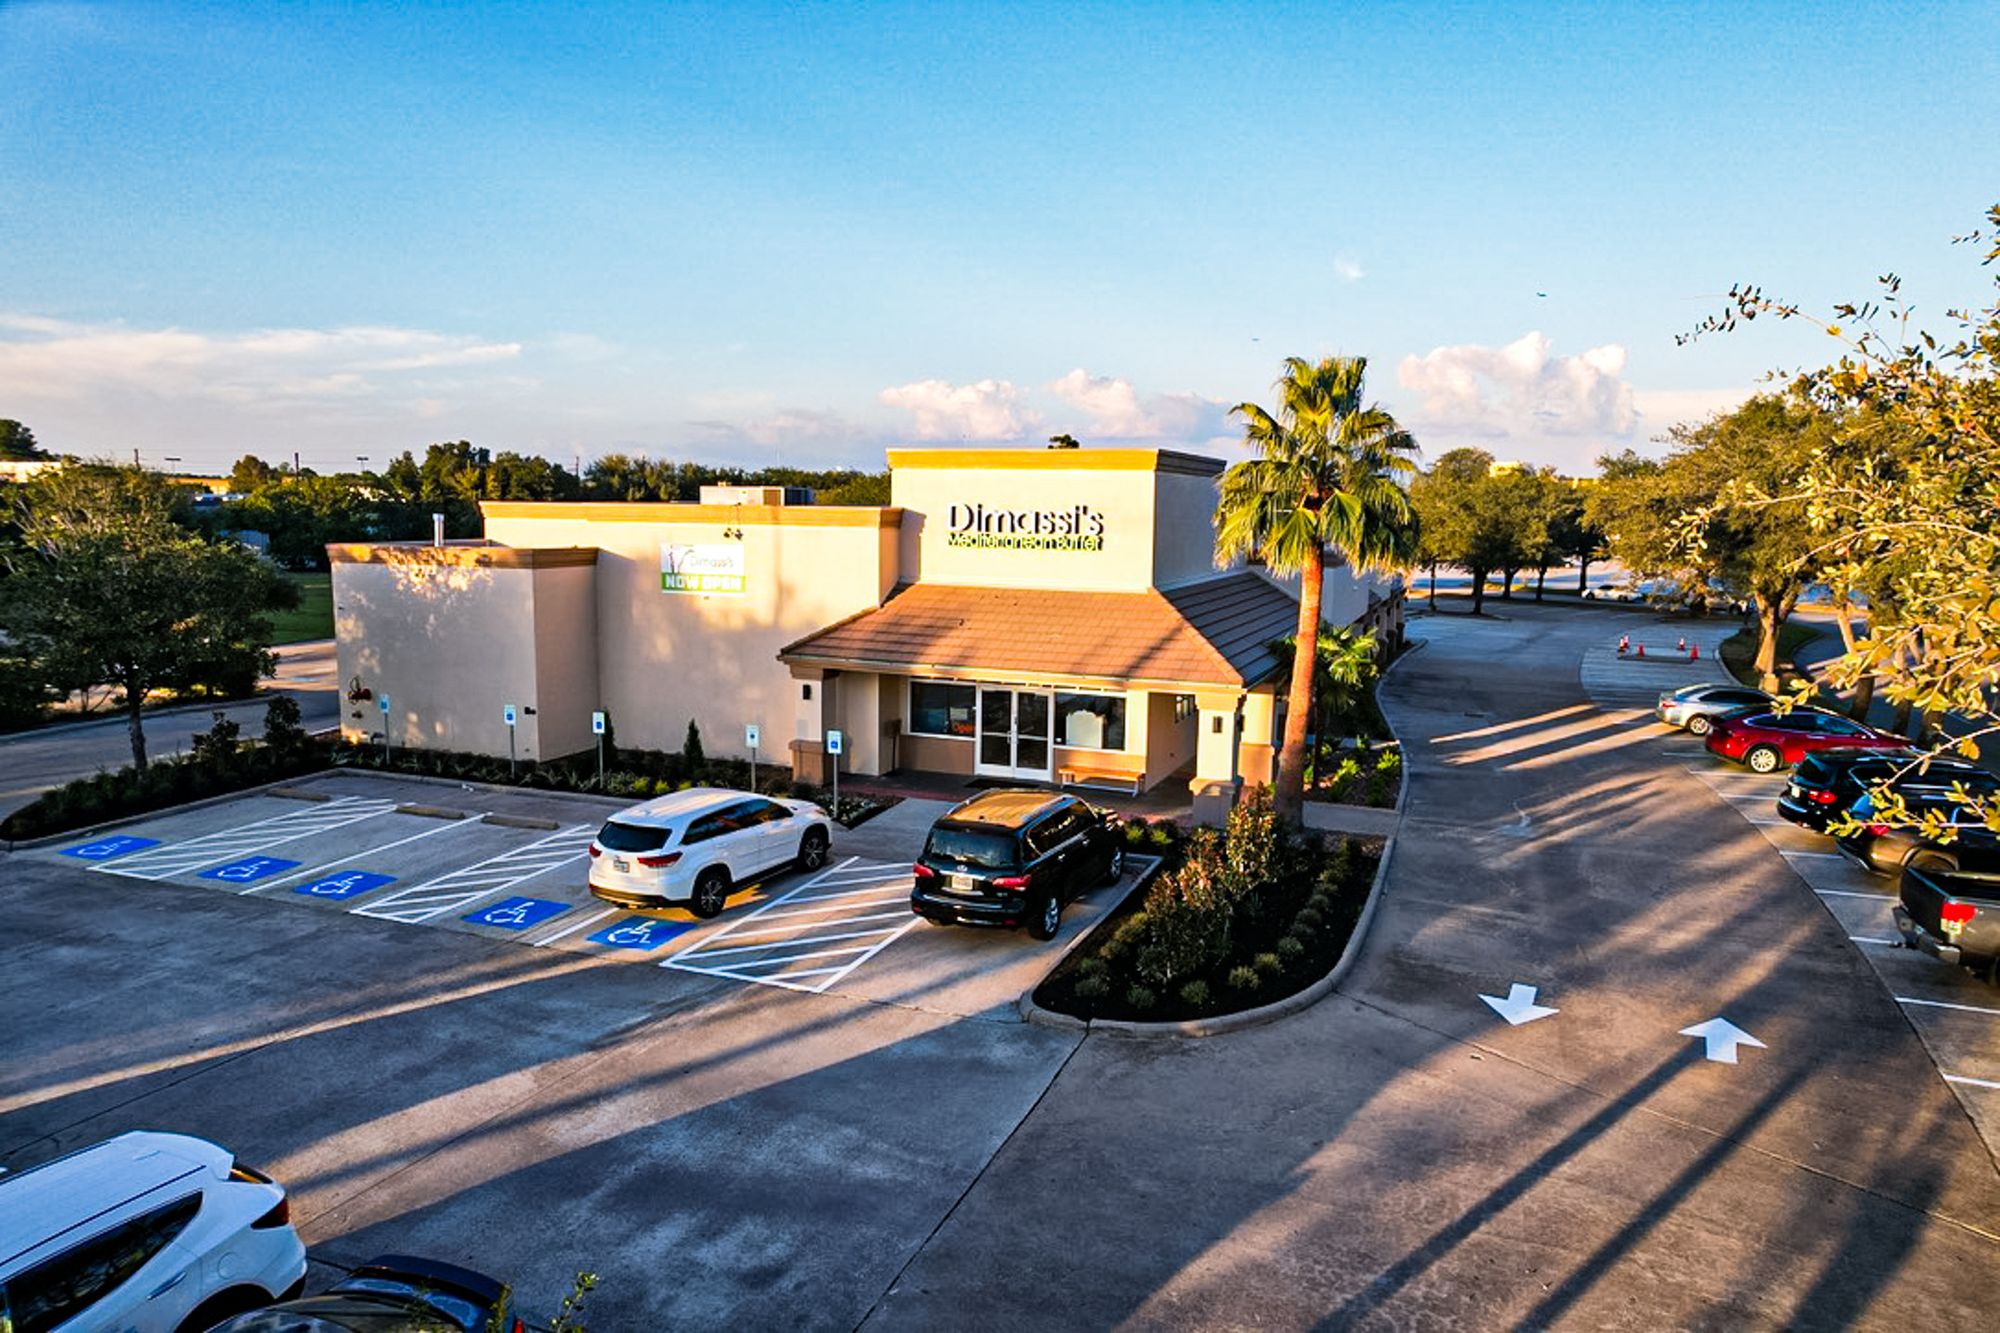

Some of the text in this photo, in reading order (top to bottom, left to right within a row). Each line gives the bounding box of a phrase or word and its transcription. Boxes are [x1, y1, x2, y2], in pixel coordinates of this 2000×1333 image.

[949, 503, 1104, 535] Dimassi's
[666, 574, 742, 590] NOW OPEN
